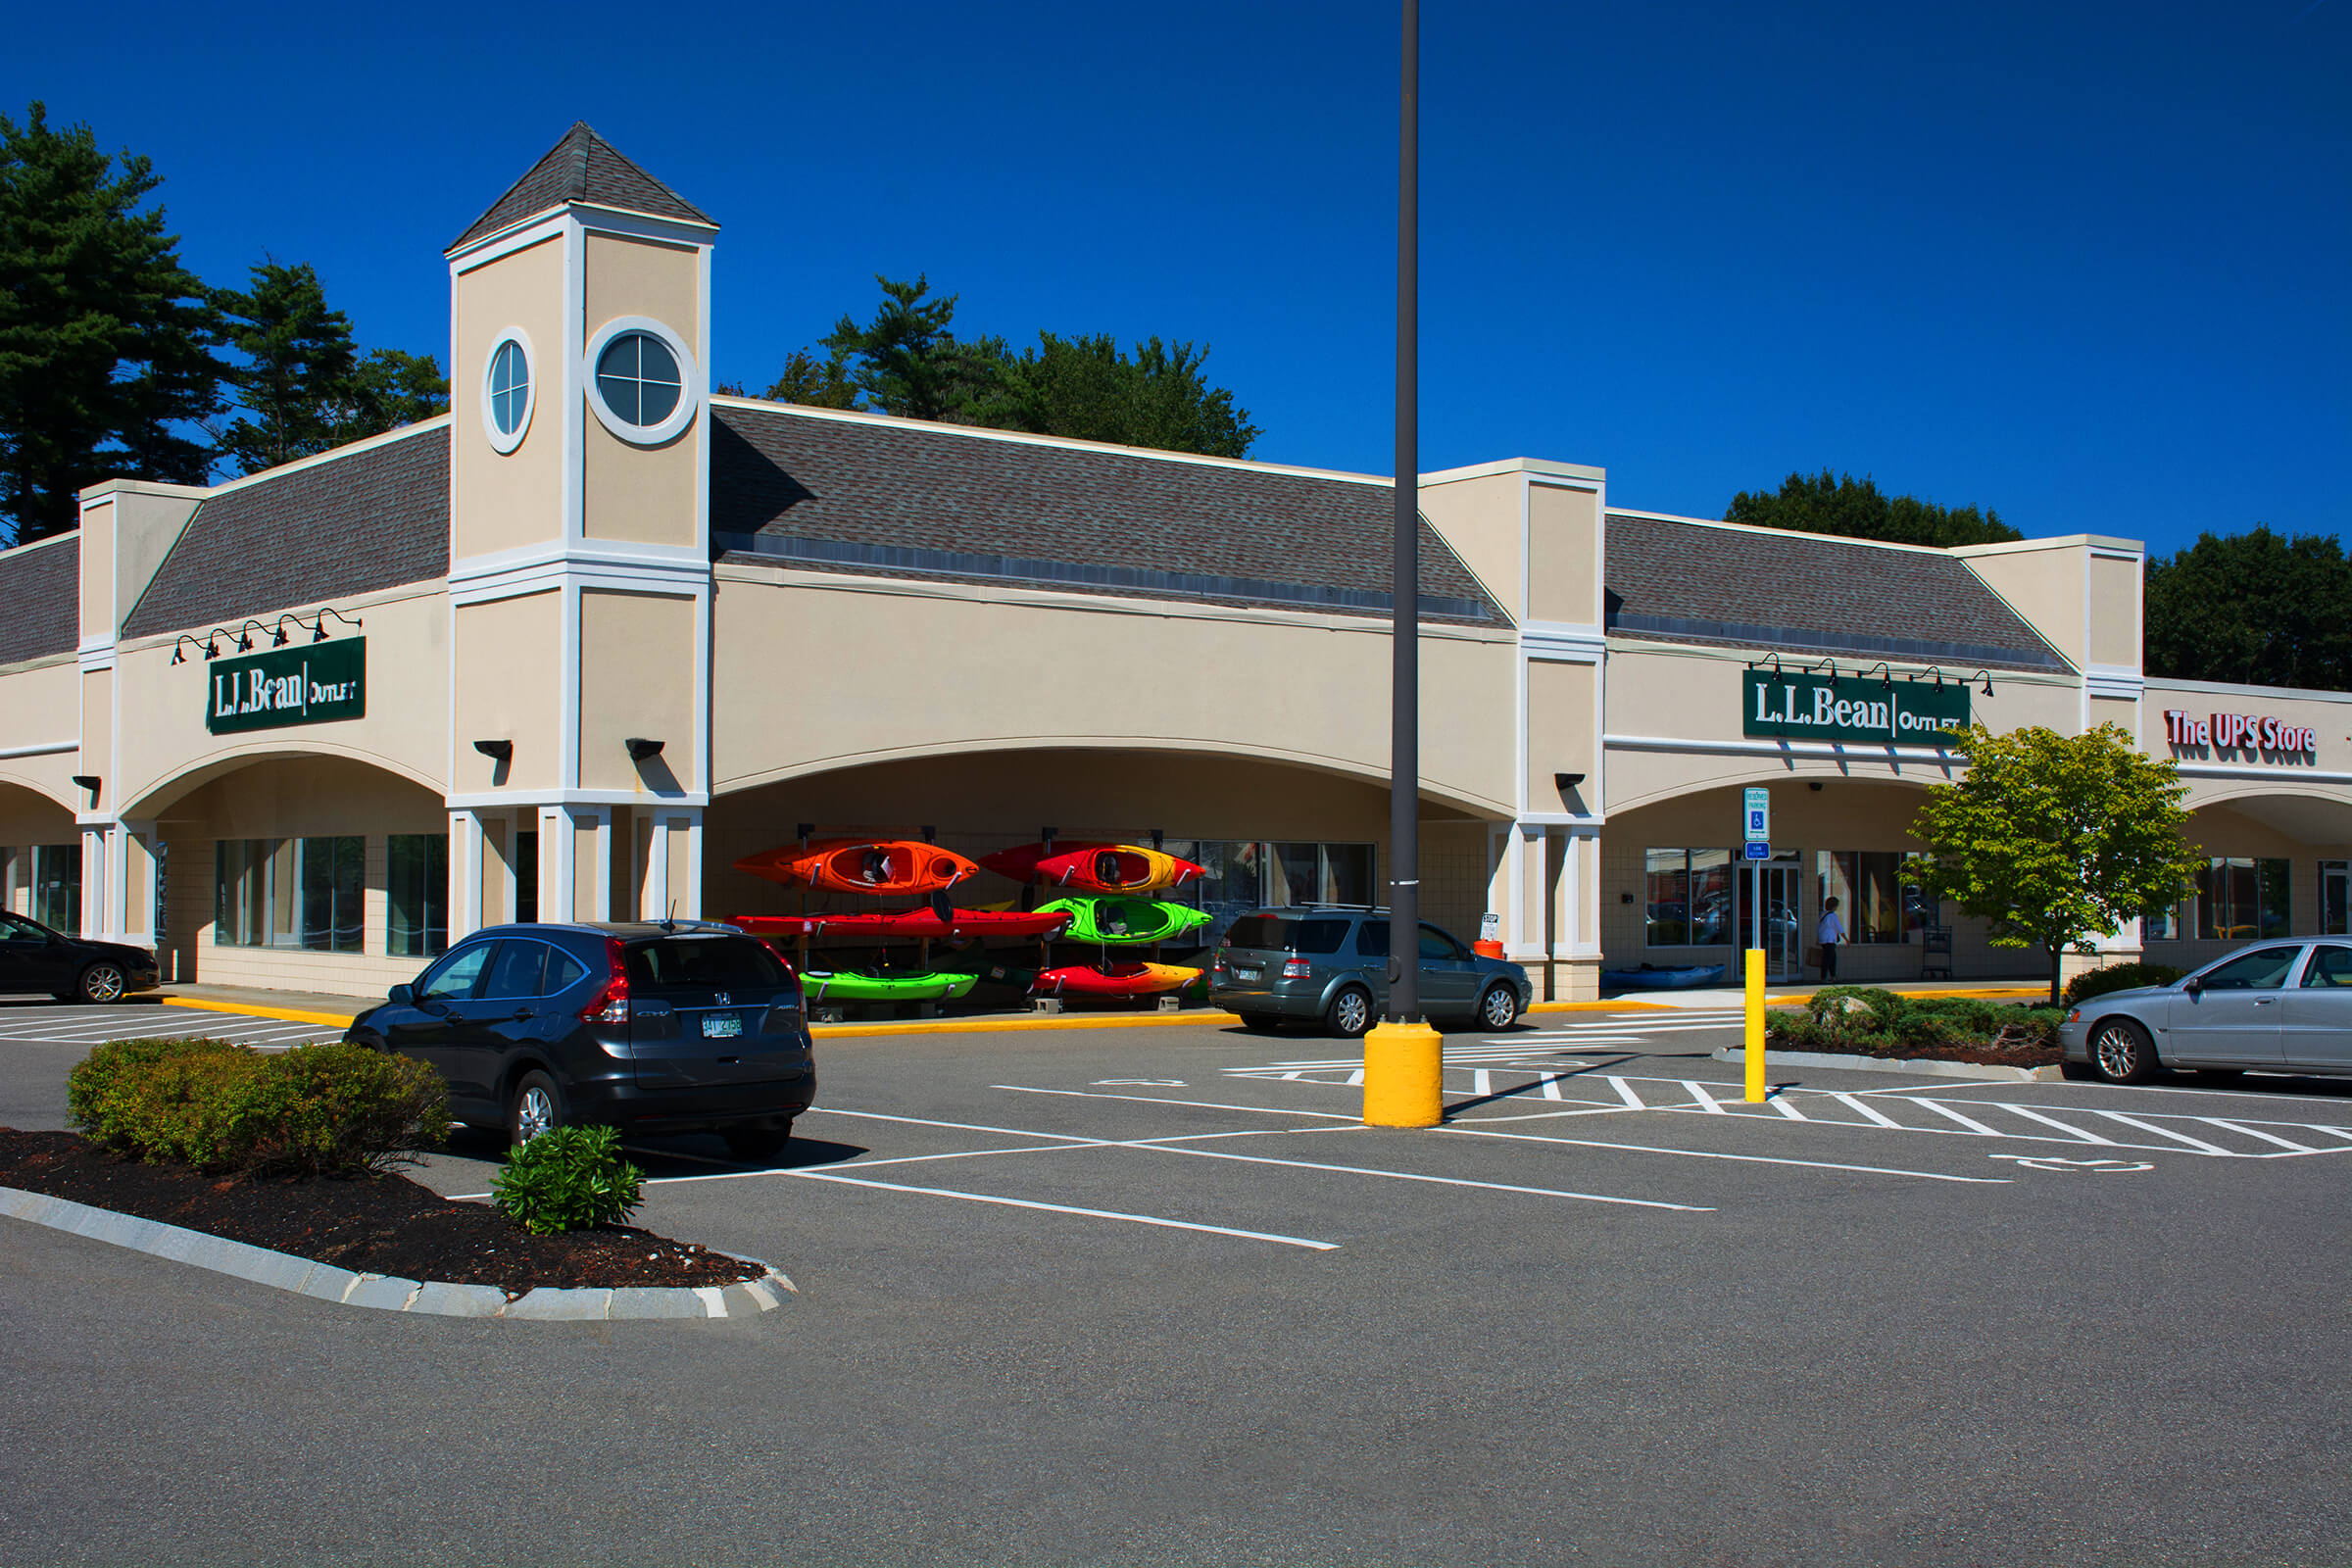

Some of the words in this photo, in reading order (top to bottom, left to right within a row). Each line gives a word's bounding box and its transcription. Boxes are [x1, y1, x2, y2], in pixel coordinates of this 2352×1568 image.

[1756, 683, 1888, 729] L.L.Bean
[2167, 710, 2209, 746] The
[2214, 713, 2258, 749] UPS
[2262, 716, 2316, 753] Store
